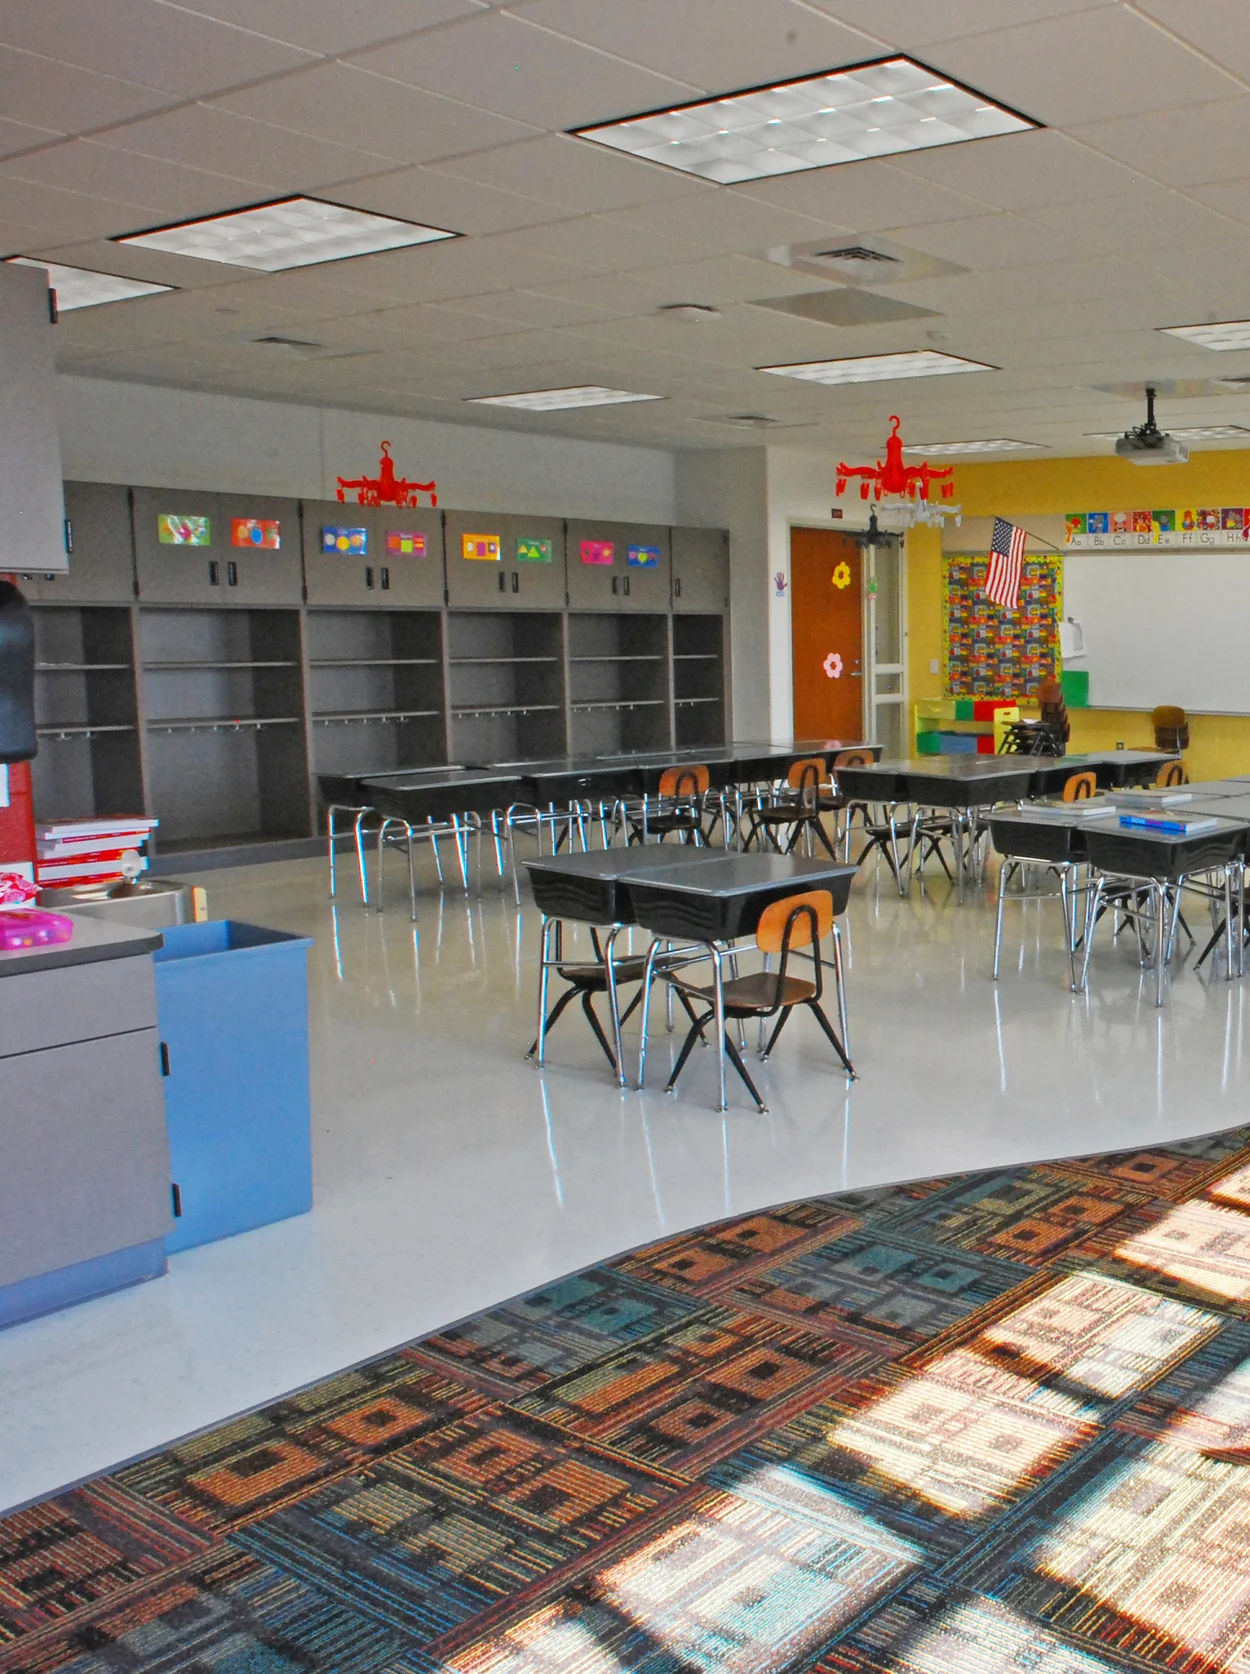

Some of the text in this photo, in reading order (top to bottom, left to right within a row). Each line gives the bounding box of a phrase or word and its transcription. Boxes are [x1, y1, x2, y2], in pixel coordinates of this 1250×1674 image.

[1070, 536, 1081, 546] Aa
[1094, 536, 1104, 546] Bb
[1113, 536, 1126, 546] Cc
[1137, 534, 1149, 544] Dd
[1182, 533, 1192, 543] Ff
[1200, 533, 1215, 545] Gg
[1227, 533, 1241, 542] Hh
